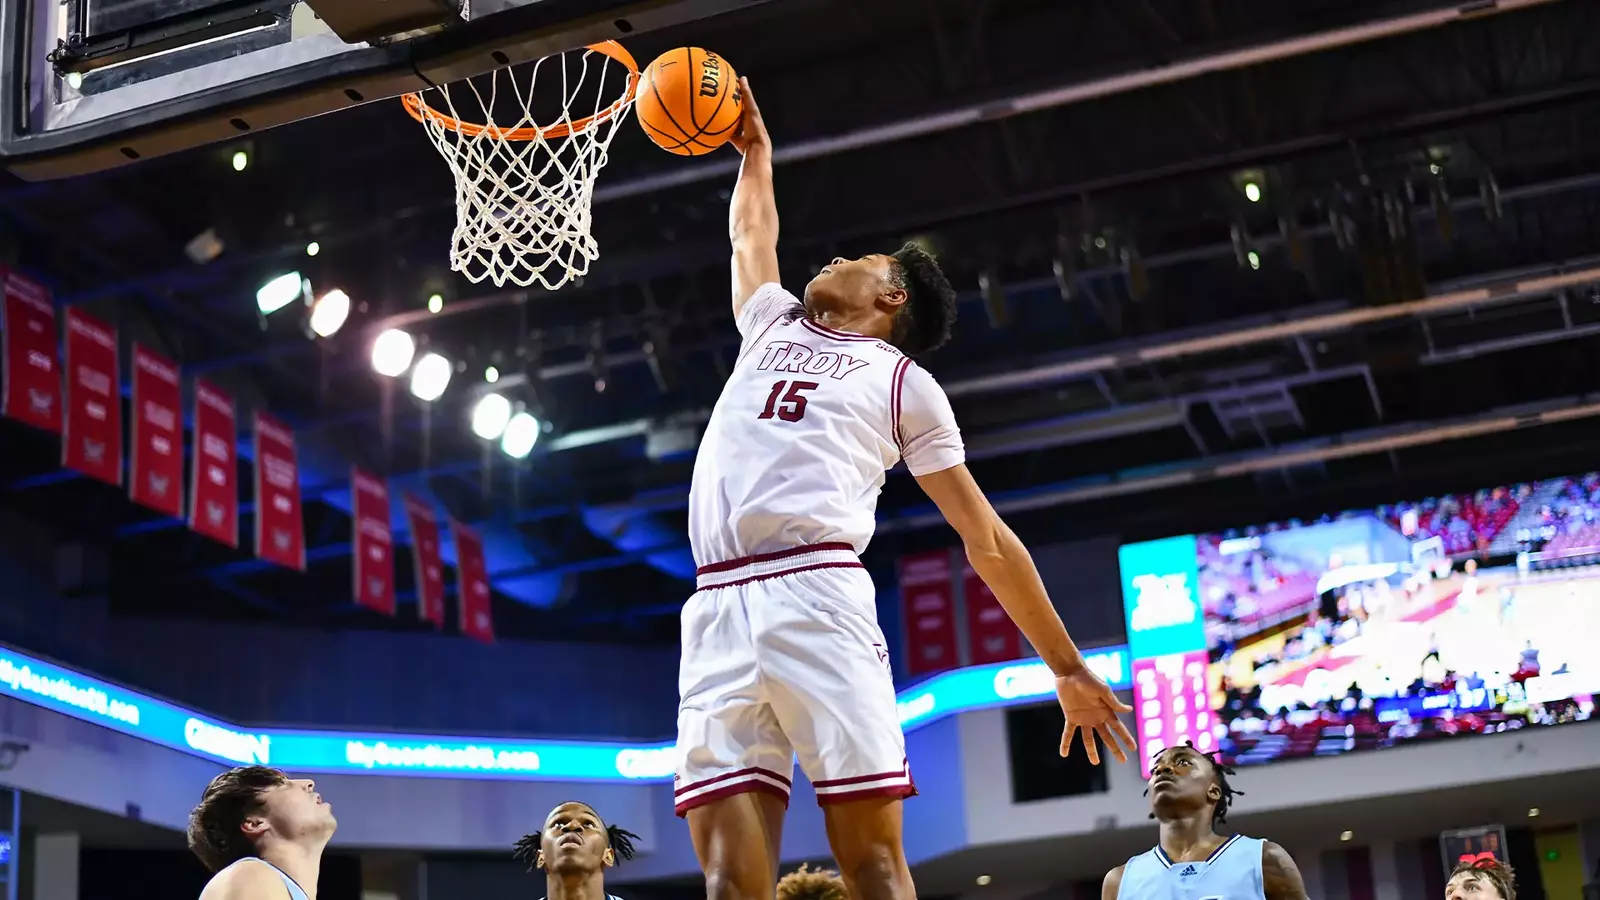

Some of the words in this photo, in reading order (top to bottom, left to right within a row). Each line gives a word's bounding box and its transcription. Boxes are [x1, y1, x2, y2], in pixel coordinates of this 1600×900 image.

[699, 50, 721, 97] Wilso
[757, 340, 870, 380] TROY
[757, 380, 820, 423] 15
